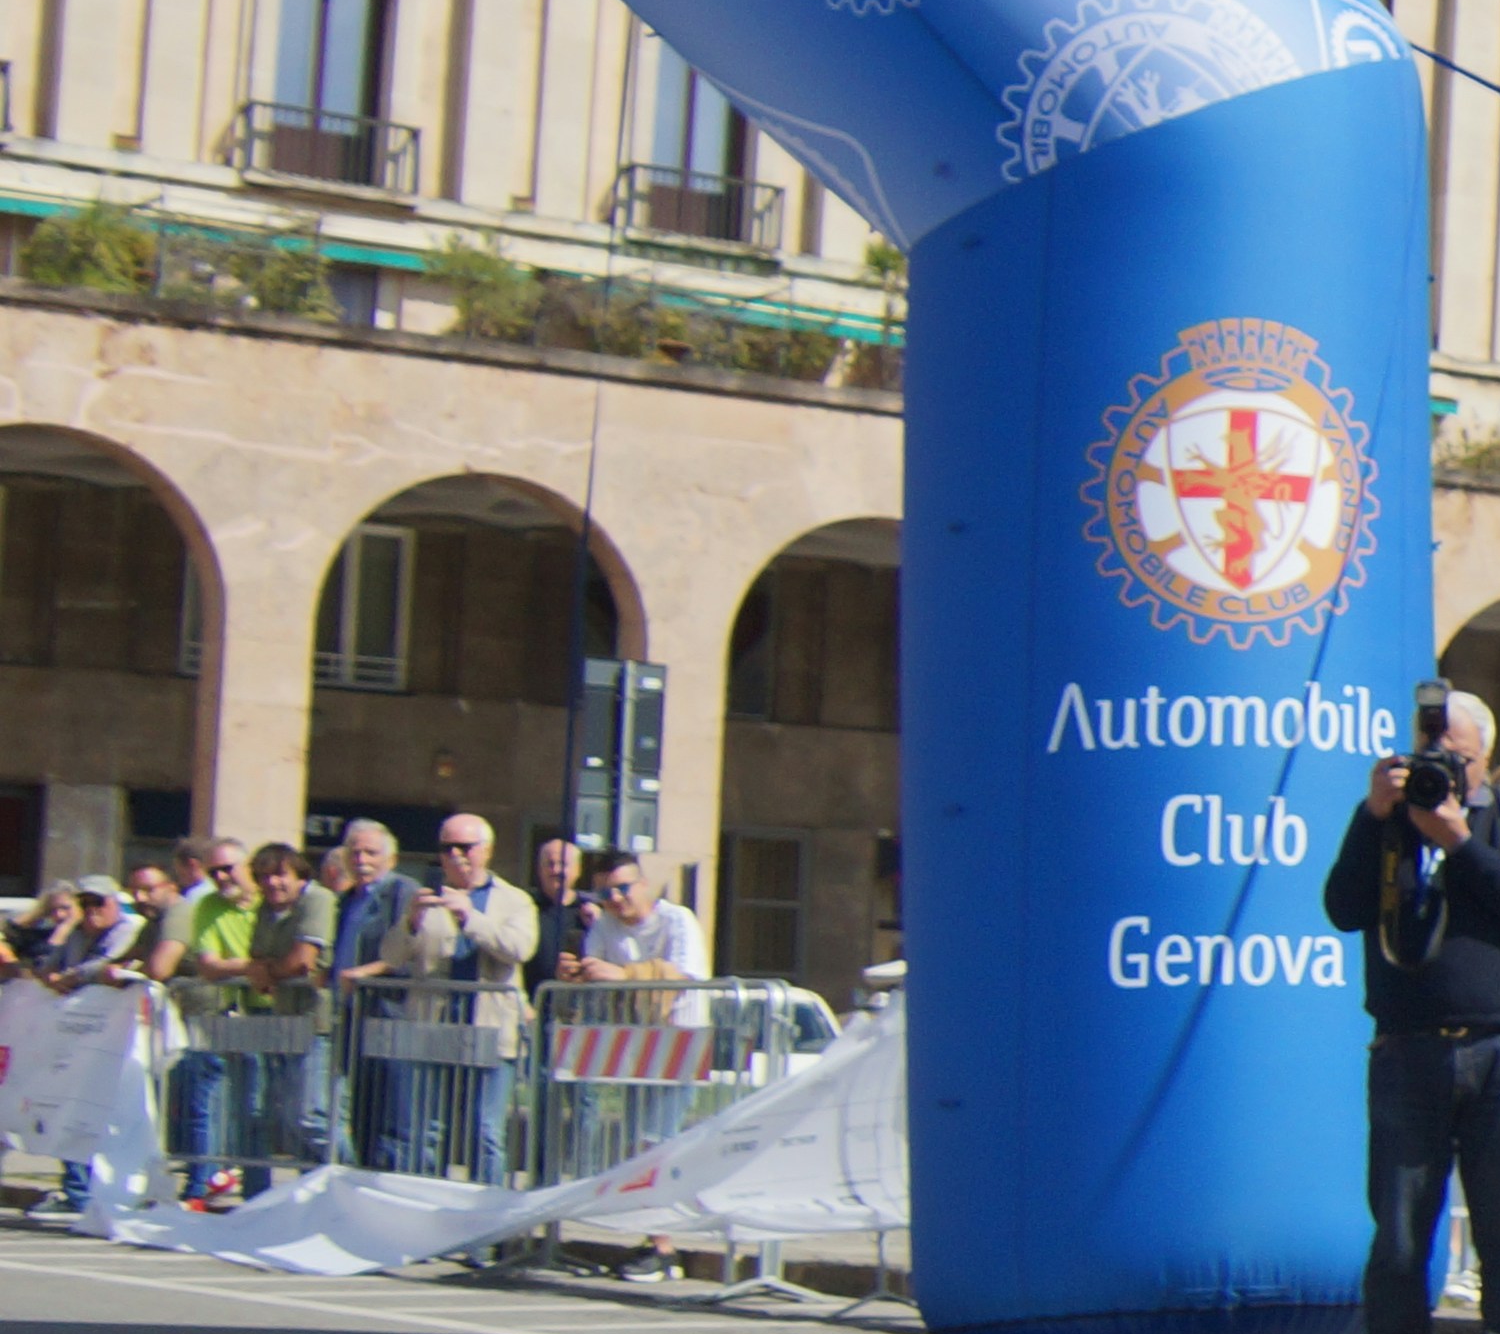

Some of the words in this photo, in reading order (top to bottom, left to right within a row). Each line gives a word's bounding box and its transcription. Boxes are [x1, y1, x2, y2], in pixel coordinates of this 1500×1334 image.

[1116, 397, 1207, 607] AUTOMOBILE
[1219, 583, 1311, 615] CLUB
[1047, 680, 1397, 758] Automobile
[1161, 794, 1308, 867] Club
[1108, 916, 1346, 988] Genova
